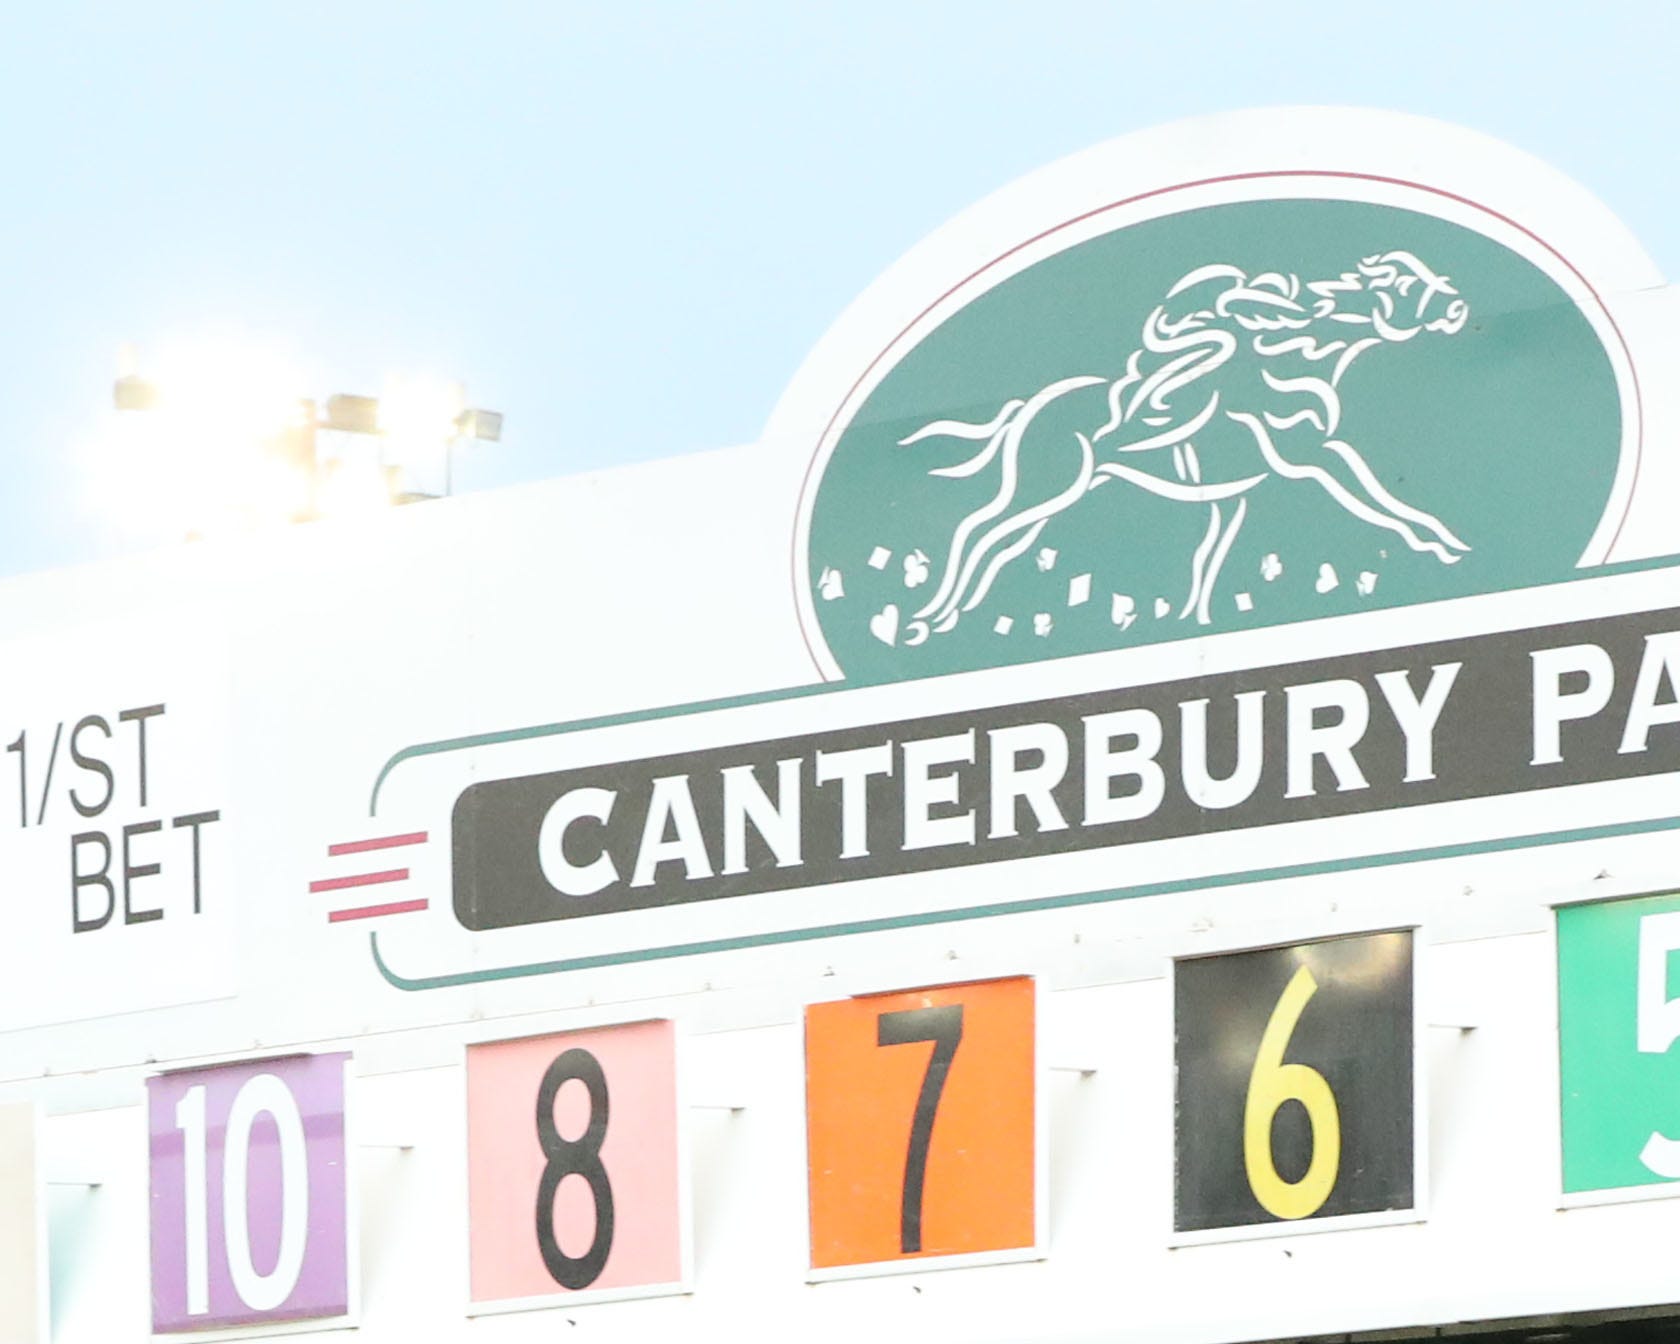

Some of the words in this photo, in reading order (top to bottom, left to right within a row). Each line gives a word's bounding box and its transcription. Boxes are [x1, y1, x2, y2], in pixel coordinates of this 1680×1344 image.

[7, 703, 165, 829] 1/ST
[71, 810, 220, 934] BET
[537, 661, 1463, 897] CANTERBURY
[174, 1072, 310, 1312] 10
[534, 1047, 616, 1292] 8
[876, 1003, 964, 1256] 7
[1242, 962, 1340, 1222] 6
